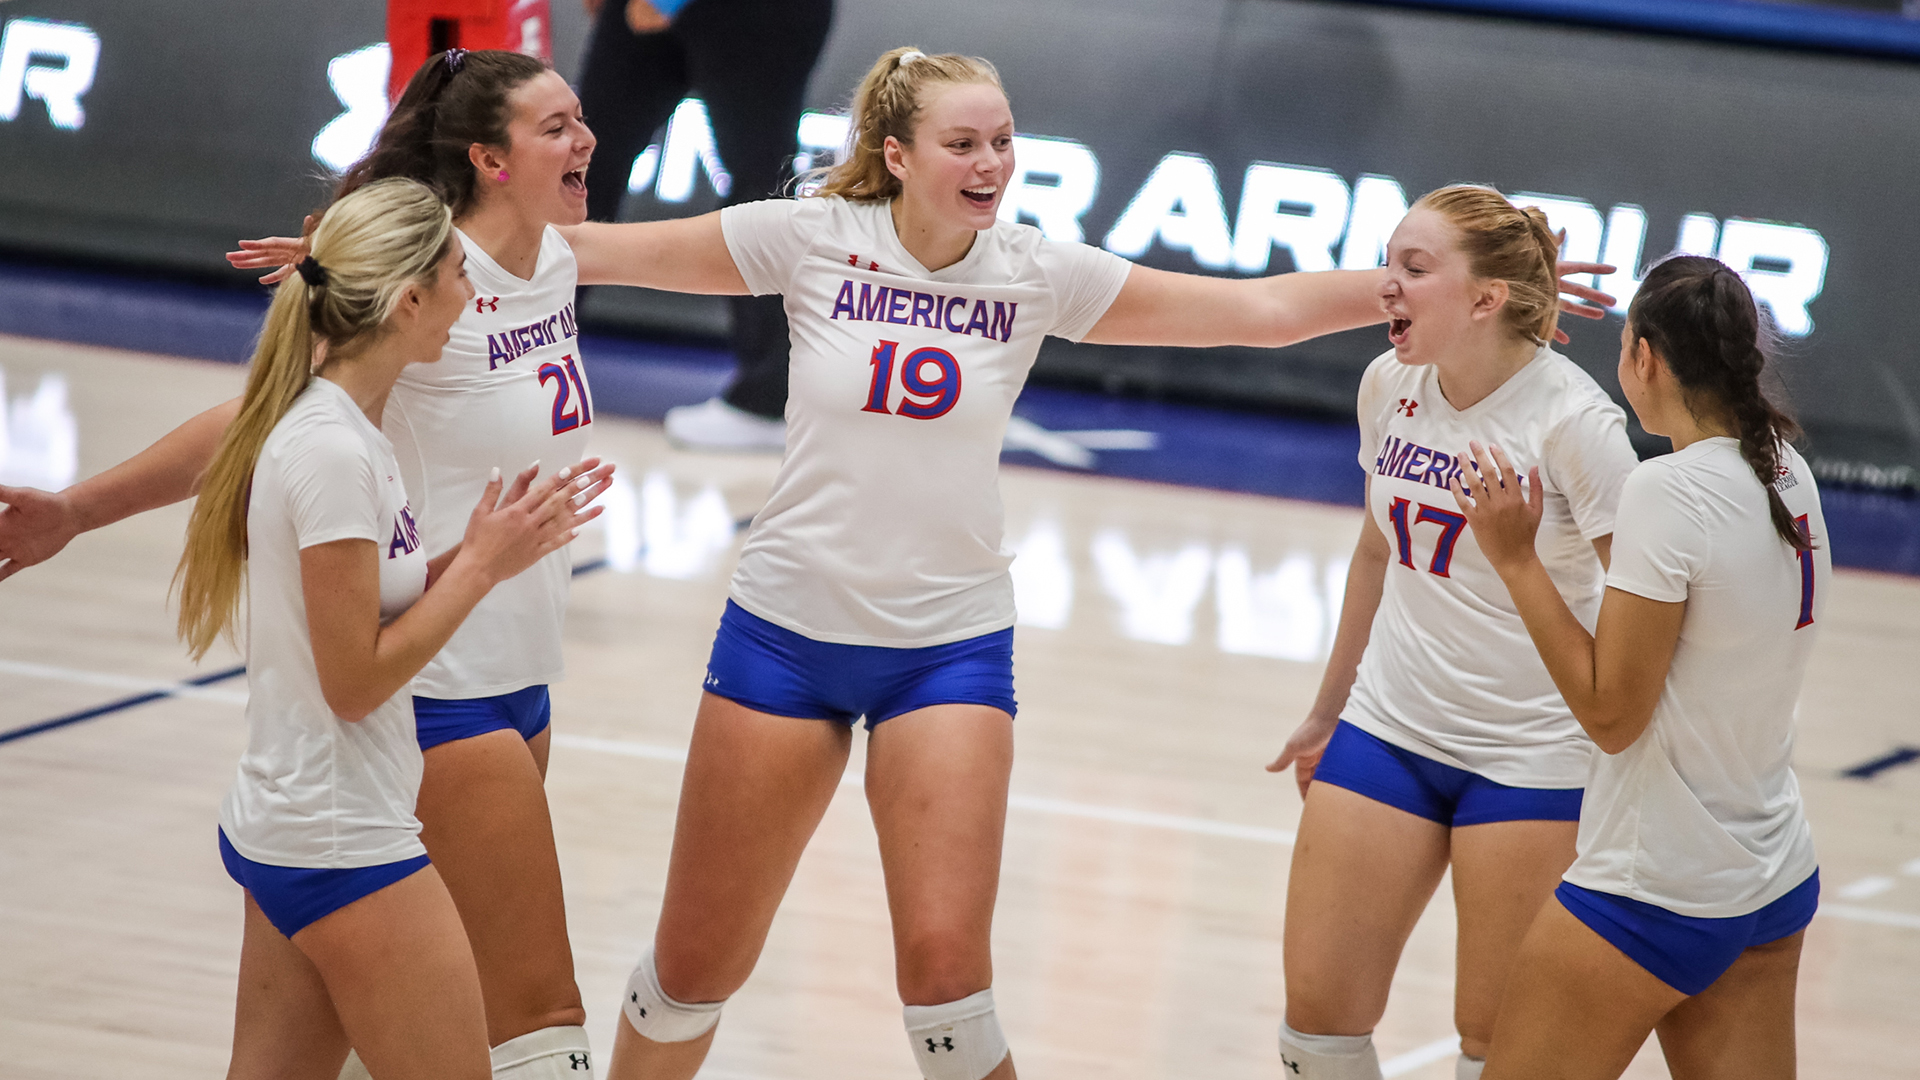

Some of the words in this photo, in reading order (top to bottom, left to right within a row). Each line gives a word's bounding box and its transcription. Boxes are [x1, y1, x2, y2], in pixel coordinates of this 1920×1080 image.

[829, 280, 1018, 343] AMERICAN
[537, 354, 591, 436] 21
[860, 339, 962, 420] 19
[1373, 435, 1524, 500] AMERIC
[1776, 479, 1799, 492] LEAGUE
[1389, 496, 1468, 579] 17
[1794, 513, 1815, 631] 1
